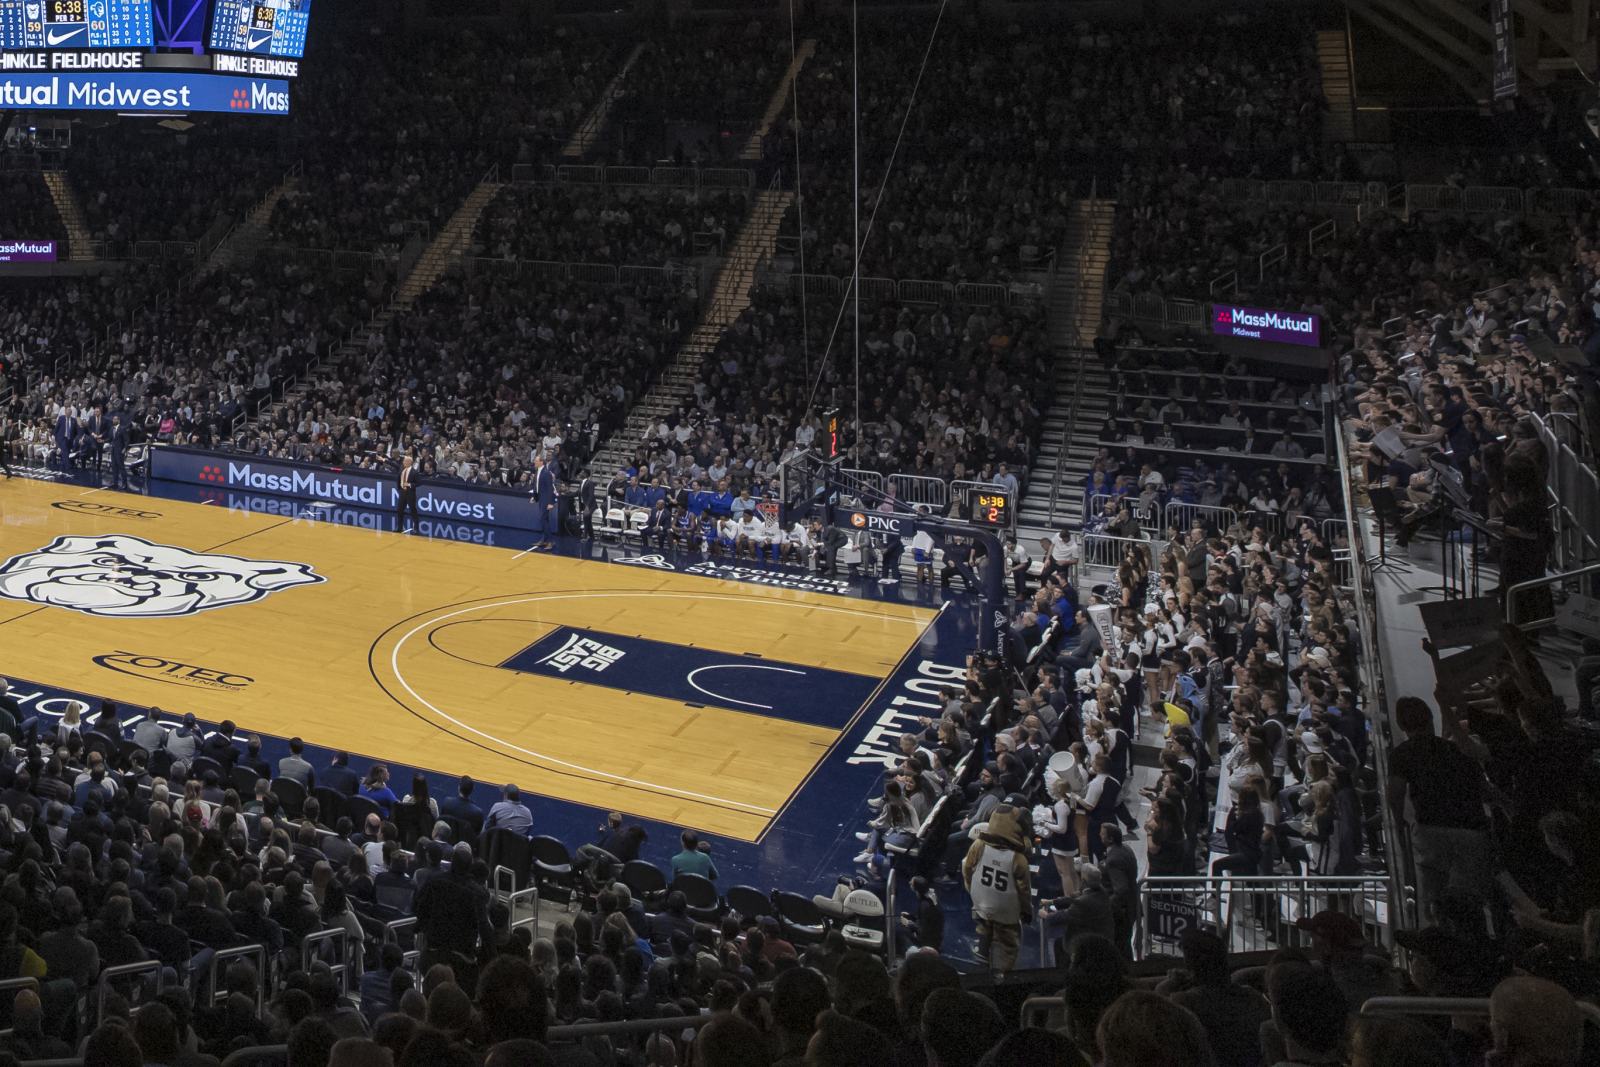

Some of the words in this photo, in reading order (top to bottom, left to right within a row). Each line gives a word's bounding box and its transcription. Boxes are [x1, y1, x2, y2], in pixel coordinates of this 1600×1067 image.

[54, 0, 81, 13] 6:38
[258, 7, 273, 20] 6:38
[69, 14, 74, 22] 2
[91, 20, 105, 31] 60
[28, 22, 41, 32] 59
[239, 25, 247, 35] 59
[274, 30, 282, 39] 60
[52, 52, 141, 69] FIELDHOUSE
[217, 54, 247, 72] HINKLE
[250, 57, 298, 76] FIELDHOUSE
[68, 82, 191, 108] Midwest
[1232, 309, 1313, 333] MassMutual
[1233, 327, 1261, 338] Midwest
[228, 462, 382, 506] MassMutual
[979, 495, 1004, 508] 6:38
[59, 500, 163, 519] ZOTEC
[988, 508, 999, 523] 2
[869, 516, 900, 531] PNC
[697, 561, 850, 587] Ascension
[1442, 617, 1485, 629] BUTLER
[1571, 610, 1600, 622] BUTLER
[545, 638, 603, 672] EAST
[580, 645, 626, 672] BIG
[104, 650, 255, 686] ZOTEC
[980, 865, 1009, 892] 55
[849, 896, 878, 908] BUTLER
[1150, 900, 1195, 916] SECTION
[1160, 914, 1187, 937] 112
